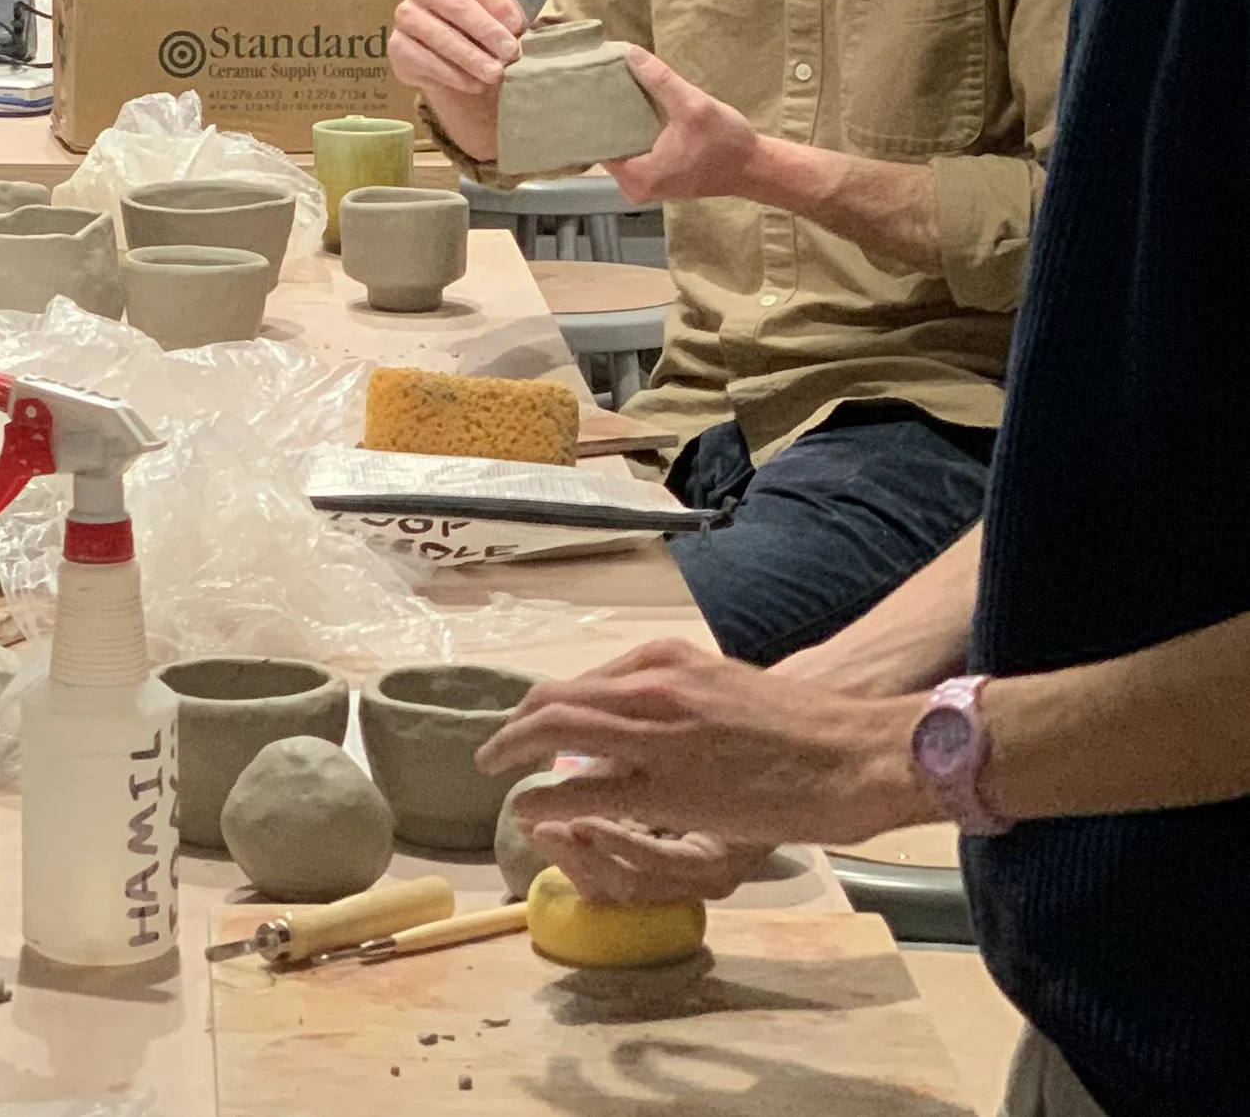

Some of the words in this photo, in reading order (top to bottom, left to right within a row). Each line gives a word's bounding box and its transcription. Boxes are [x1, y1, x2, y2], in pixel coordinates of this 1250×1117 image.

[209, 25, 389, 59] Standard
[208, 63, 267, 79] Ceramic
[271, 63, 318, 83] Supply
[323, 63, 389, 83] Company
[125, 728, 163, 948] HAMIL
